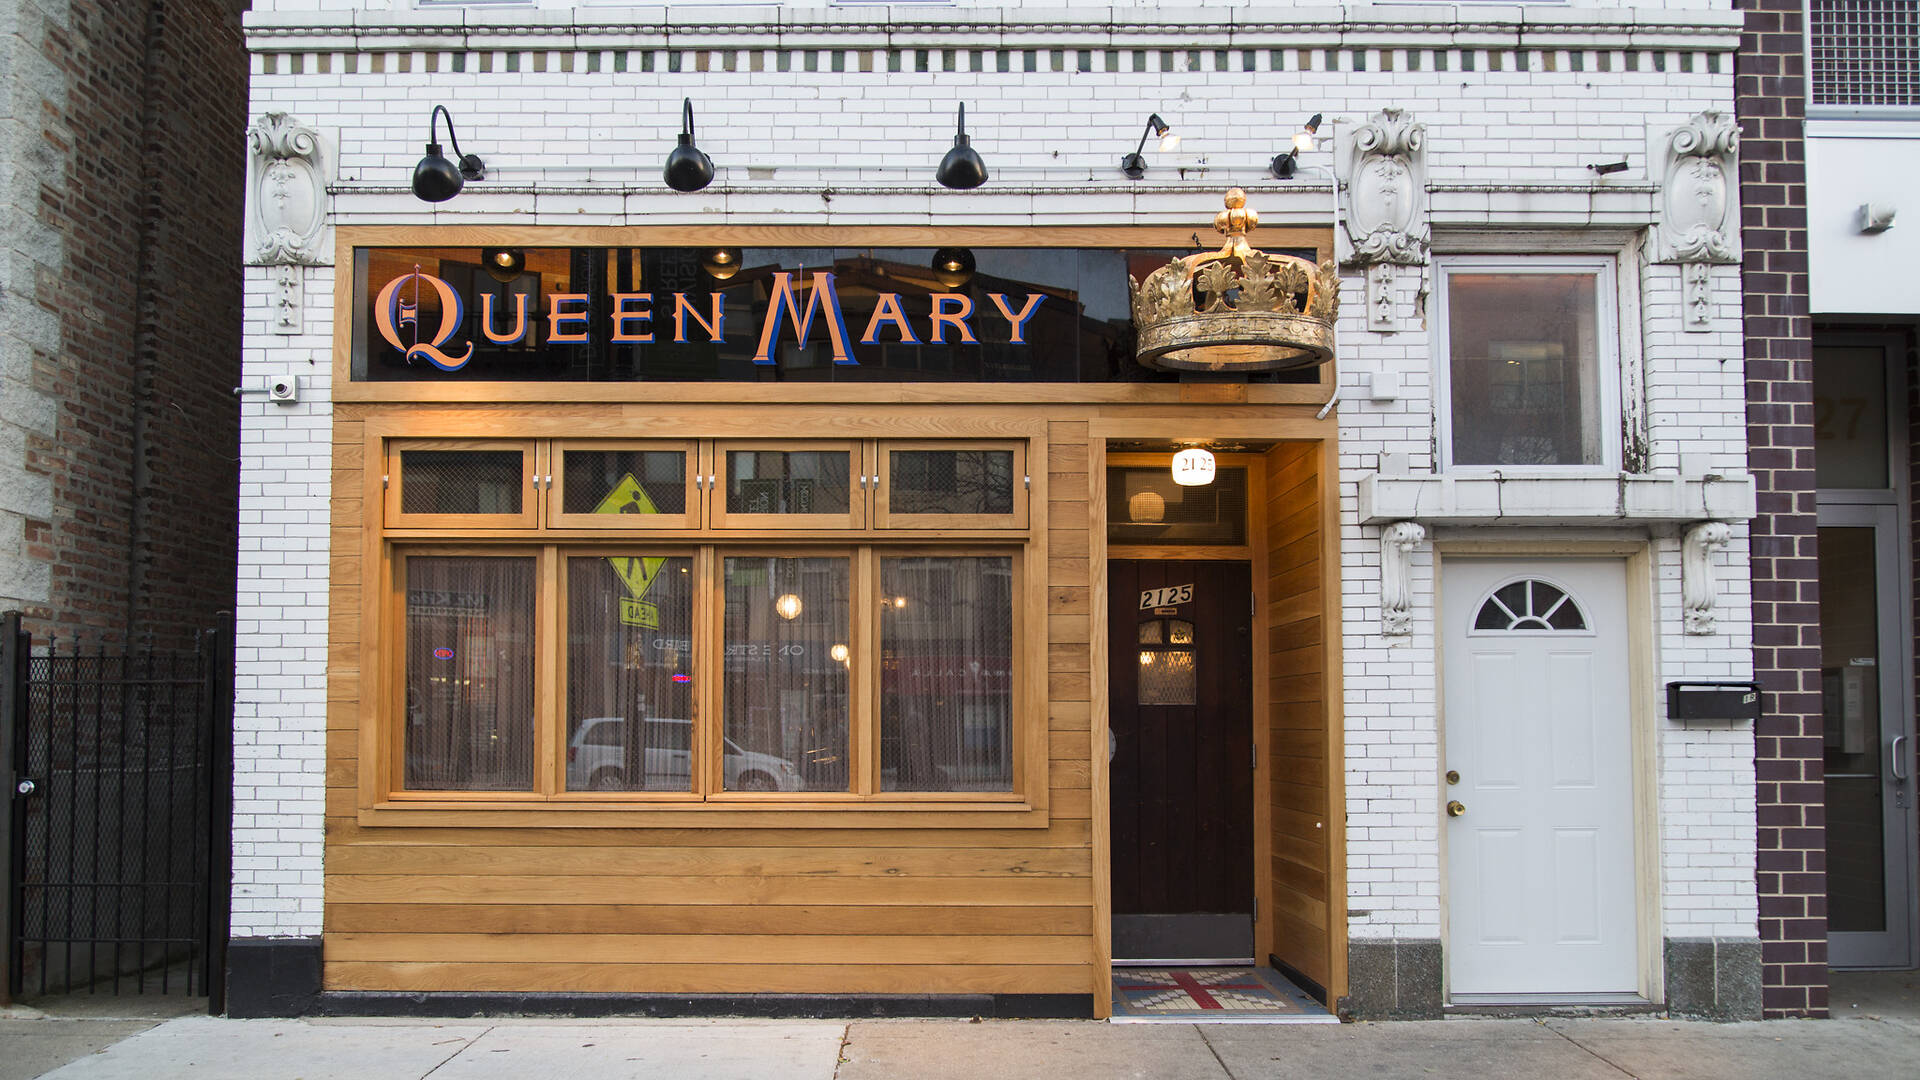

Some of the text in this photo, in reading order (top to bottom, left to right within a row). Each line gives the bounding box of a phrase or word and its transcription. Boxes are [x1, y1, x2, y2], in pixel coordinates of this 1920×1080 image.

[375, 268, 727, 371] QUEEN
[752, 268, 1048, 365] MARY
[1142, 586, 1191, 607] 2125
